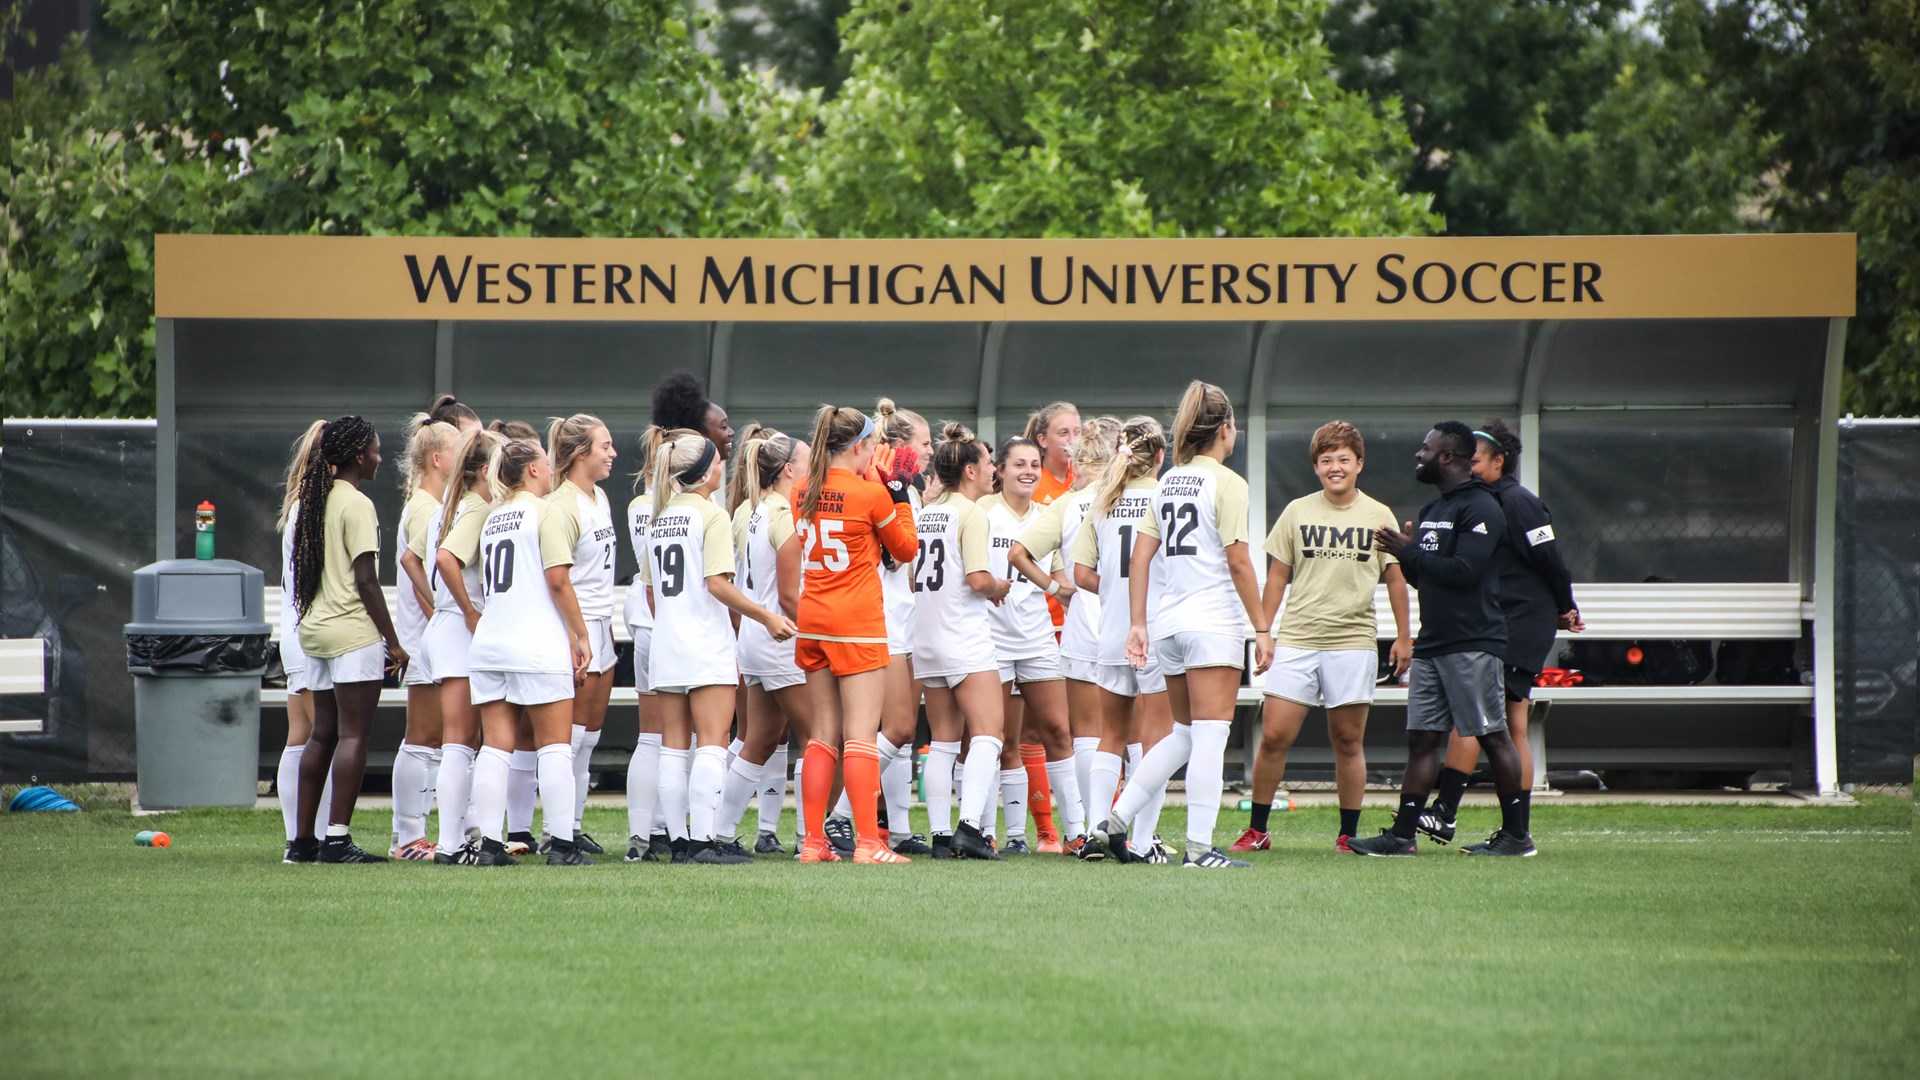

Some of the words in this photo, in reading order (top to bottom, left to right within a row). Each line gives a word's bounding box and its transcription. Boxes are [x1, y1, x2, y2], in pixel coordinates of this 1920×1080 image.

[403, 254, 676, 304] WESTERN
[699, 256, 1005, 305] MICHIGAN
[1030, 256, 1358, 305] UNIVERSITY
[1376, 253, 1605, 303] SOCCER
[1161, 487, 1201, 497] MICHIGAN
[1165, 476, 1205, 487] WESTERN
[795, 518, 850, 573] 25
[1161, 502, 1199, 557] 22
[1300, 524, 1375, 551] WMU
[1314, 549, 1359, 561] SOCCER
[485, 538, 515, 597] 10
[653, 543, 685, 598] 19
[914, 538, 945, 592] 23
